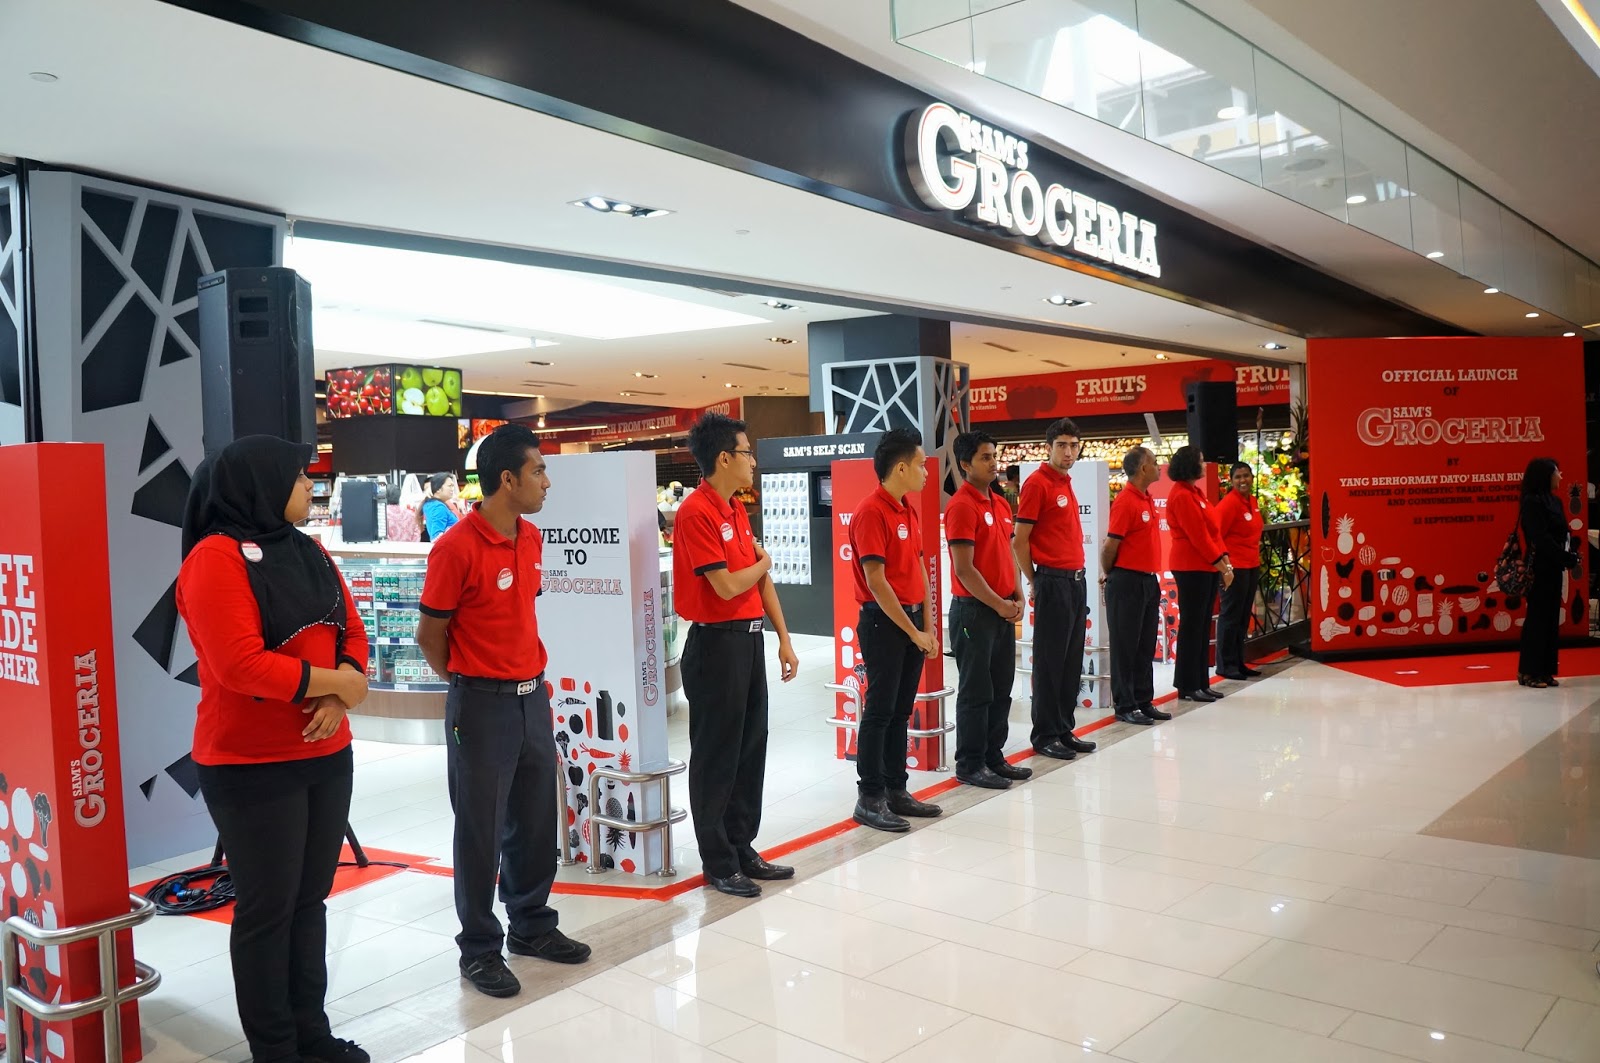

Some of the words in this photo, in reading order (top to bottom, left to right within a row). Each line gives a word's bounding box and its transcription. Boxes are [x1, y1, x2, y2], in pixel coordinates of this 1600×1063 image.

[970, 119, 1029, 170] SAM'S
[916, 102, 1161, 278] GROCERIA
[1235, 365, 1290, 384] FRUI
[1382, 369, 1455, 382] OFFICIAL
[1457, 368, 1518, 381] LAUNCH
[1075, 375, 1147, 396] FRUITS
[1443, 386, 1460, 396] OF
[969, 385, 1008, 404] UITS
[1076, 396, 1096, 404] Packed
[1110, 394, 1135, 402] vitamins
[1393, 406, 1432, 418] SAM'S
[617, 420, 641, 433] FROM
[642, 418, 656, 430] THE
[656, 415, 677, 429] FARM
[1356, 407, 1545, 446] GROCERIA
[783, 446, 812, 457] SAM'S
[813, 444, 837, 456] SELF
[838, 443, 865, 454] SCAN
[1447, 457, 1459, 467] BY
[1339, 477, 1370, 487] YANG
[1371, 475, 1437, 486] BERHORMAT
[1440, 474, 1470, 484] DATO'
[1472, 473, 1503, 483] HASAN
[1507, 472, 1525, 482] BIN
[1349, 488, 1392, 497] MINISTER
[1408, 486, 1453, 495] DOMESTIC
[1387, 498, 1406, 507] AND
[1424, 515, 1474, 525] SEPTEMBER
[564, 549, 587, 565] TO
[549, 569, 567, 577] SAM'S
[0, 609, 38, 653] DE
[643, 587, 659, 707] GROCERIA
[73, 648, 107, 828] GROCERIA
[70, 759, 83, 797] SAM'S
